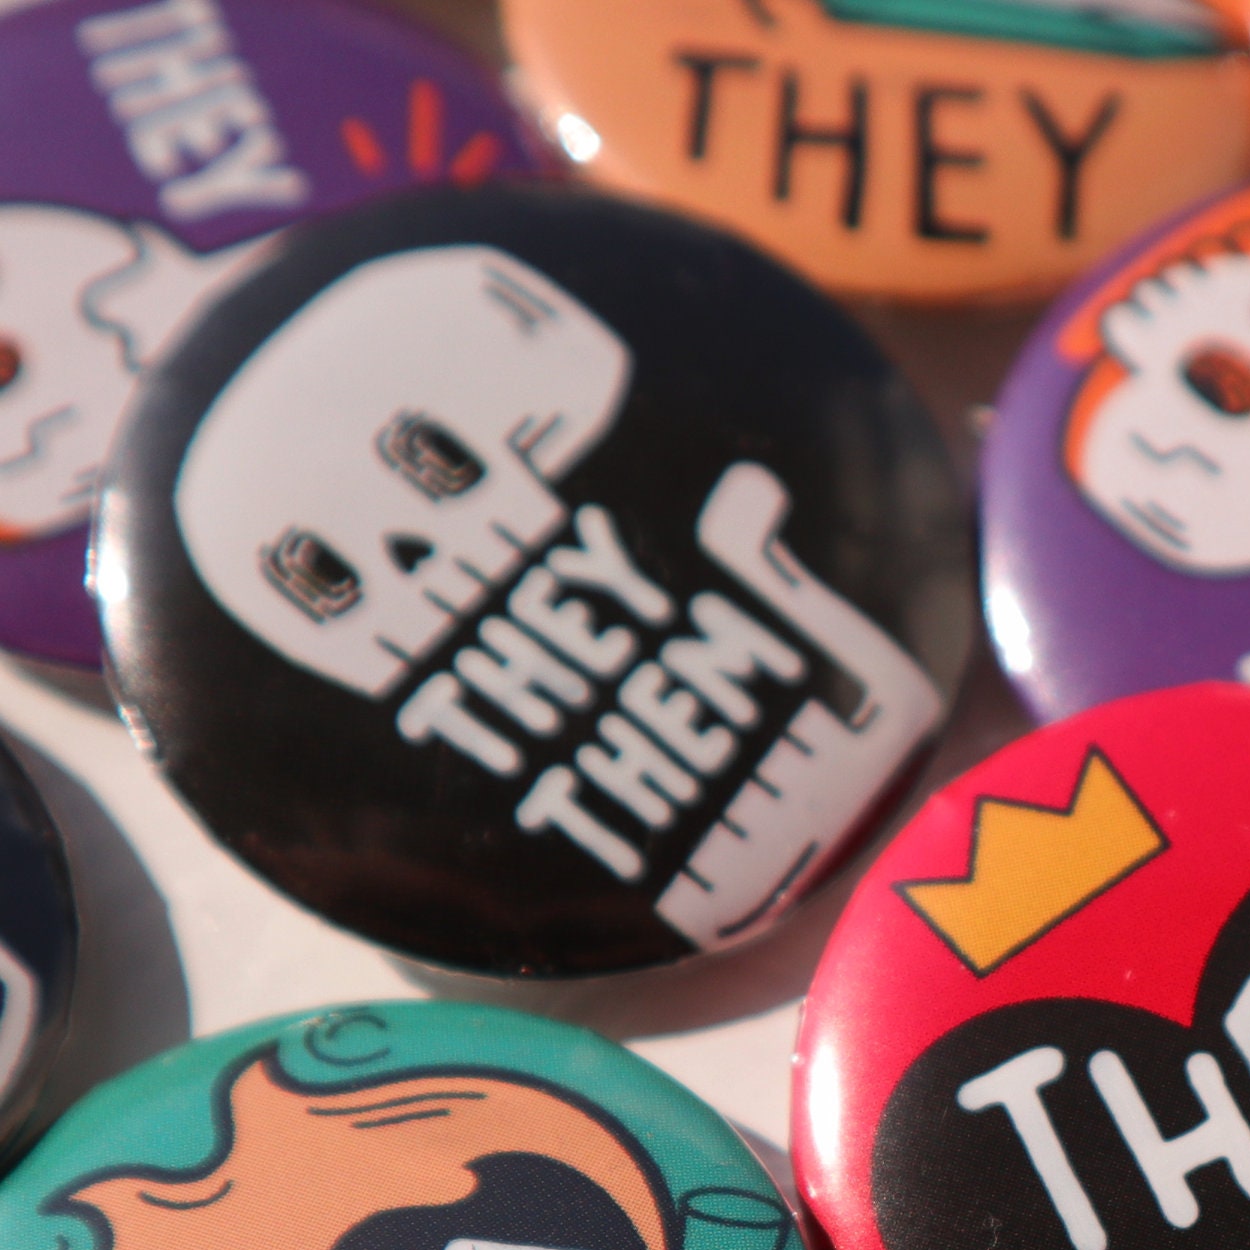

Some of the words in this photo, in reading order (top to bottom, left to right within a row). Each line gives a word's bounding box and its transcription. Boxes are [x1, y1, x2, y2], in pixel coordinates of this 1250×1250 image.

[672, 46, 1122, 245] THEY
[396, 503, 674, 777] THEY
[515, 591, 806, 882] THEM
